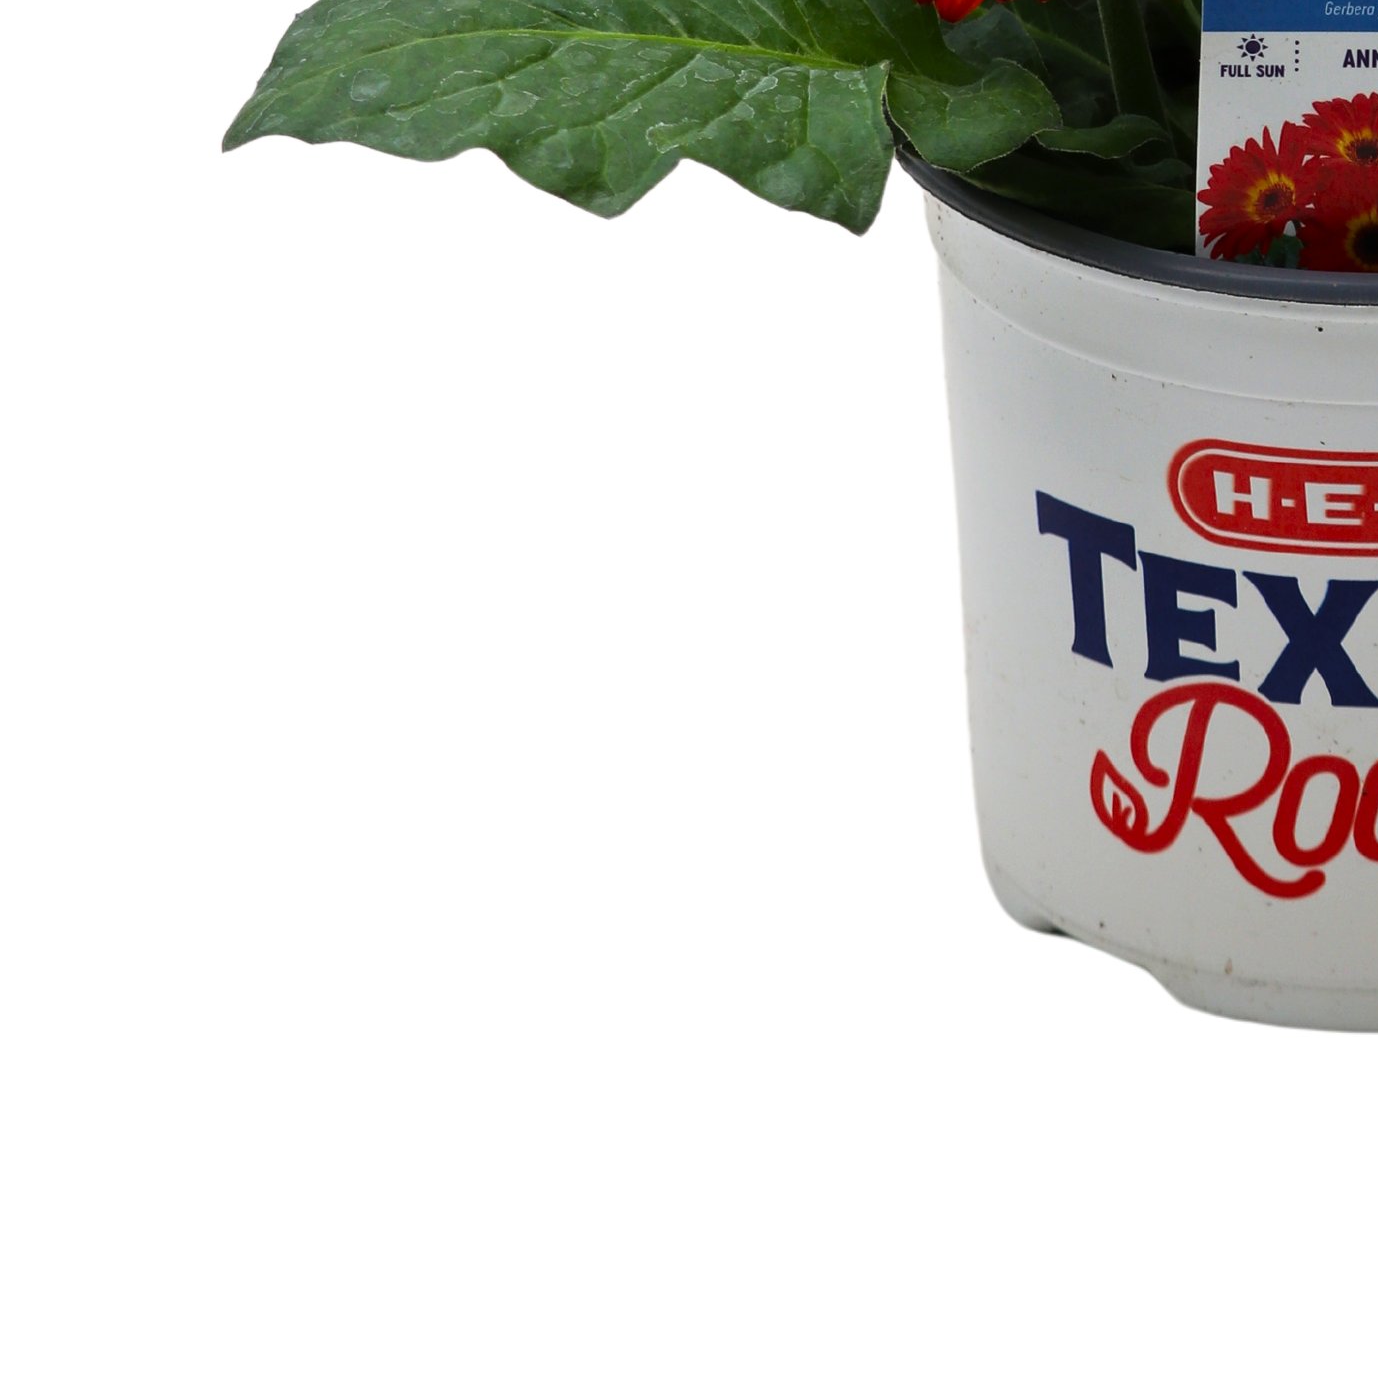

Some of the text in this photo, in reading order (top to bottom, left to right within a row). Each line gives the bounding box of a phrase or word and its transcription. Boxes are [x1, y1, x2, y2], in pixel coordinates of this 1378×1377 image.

[1324, 1, 1375, 17] Gerbera
[1220, 65, 1285, 78] FULL SUN
